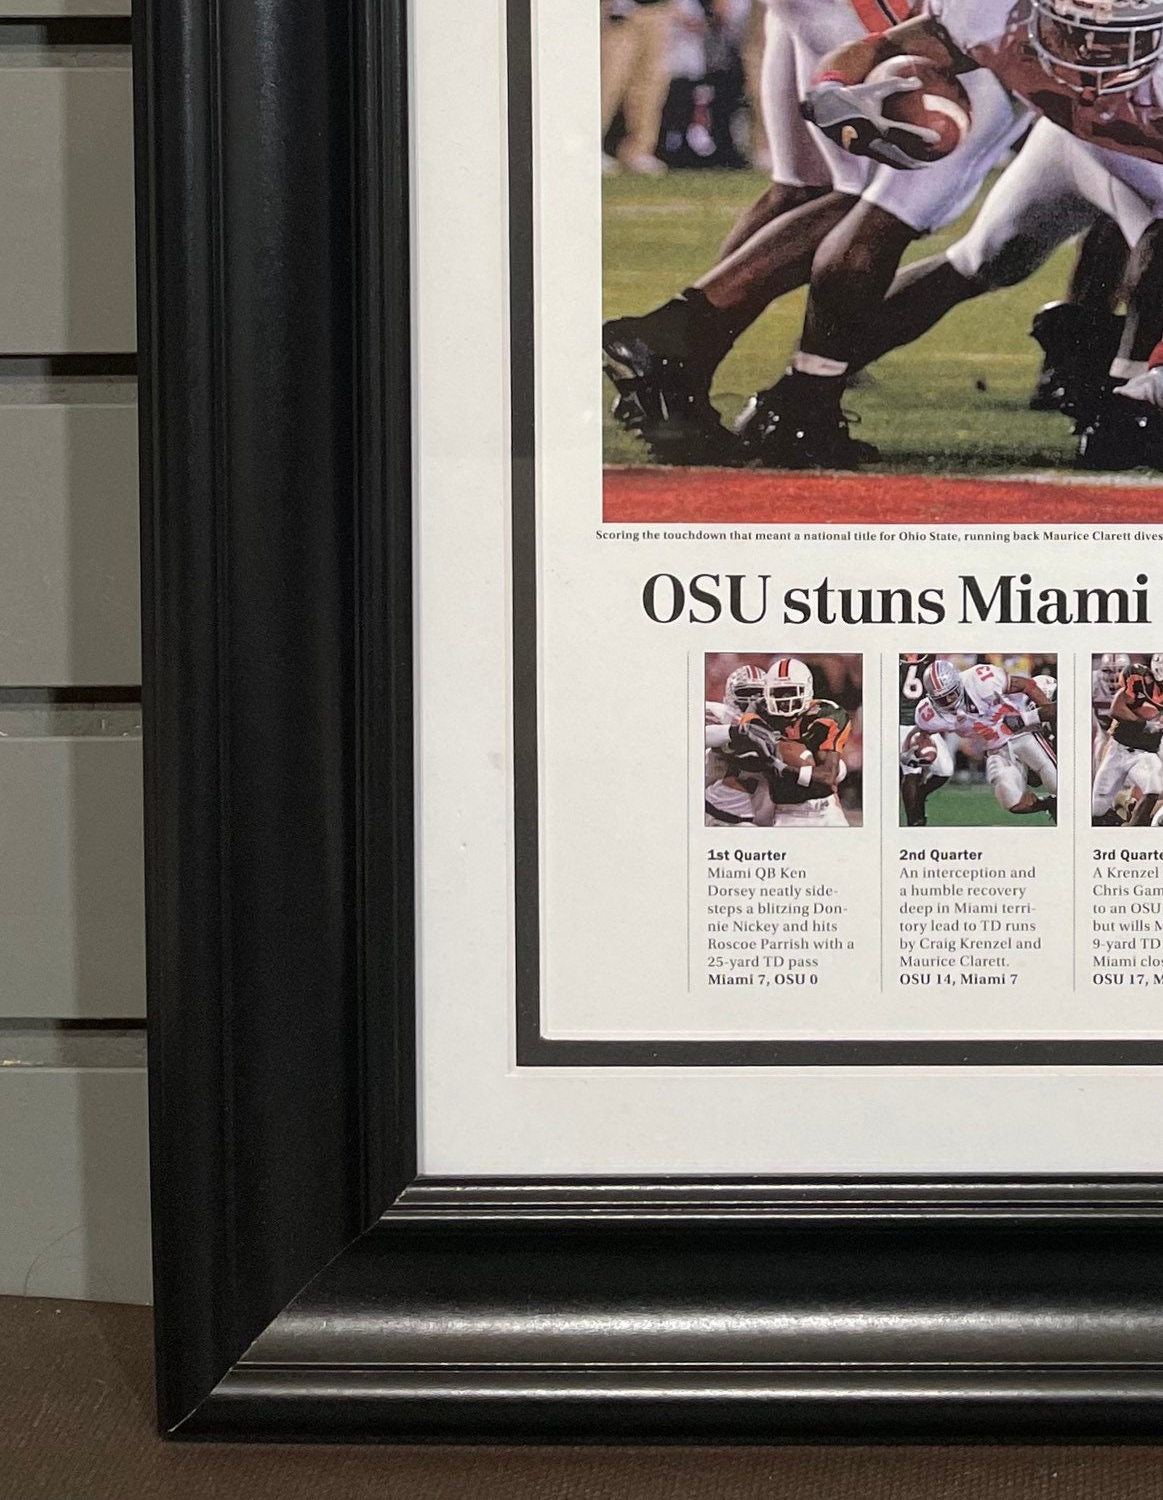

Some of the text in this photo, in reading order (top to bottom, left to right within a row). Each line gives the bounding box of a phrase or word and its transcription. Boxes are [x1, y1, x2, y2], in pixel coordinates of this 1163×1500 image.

[595, 529, 640, 543] Scoring
[641, 529, 661, 540] the
[662, 529, 728, 541] touchdown
[729, 530, 753, 541] that
[755, 531, 792, 541] meant
[793, 532, 801, 541] a
[803, 530, 851, 541] national
[853, 530, 878, 542] title
[879, 530, 897, 542] for
[898, 530, 927, 542] Ohio
[928, 530, 962, 543] State,
[963, 530, 1011, 544] running
[1012, 530, 1041, 542] back
[1042, 530, 1090, 541] Maurice
[1091, 530, 1132, 542] Clarett
[1133, 530, 1163, 541] dives
[643, 573, 771, 624] OSU
[784, 577, 945, 624] stuns
[958, 574, 1152, 624] Miami
[706, 848, 788, 864] 1st Quarter
[898, 848, 984, 863] 2nd Quarter
[1092, 848, 1117, 861] 3rd
[707, 866, 807, 882] Miami QB Ken
[898, 865, 1036, 882] An interception and
[1092, 866, 1103, 879] A
[1106, 865, 1159, 879] Krenzel
[1092, 919, 1116, 933] but
[1118, 919, 1151, 932] wills
[707, 936, 855, 951] Roscoe Parrish with a
[899, 936, 1042, 954] by Craig Krenzel and
[707, 954, 819, 971] 25-yard TD pass
[899, 955, 956, 968] Maurice
[1092, 955, 1137, 968] Miami
[707, 973, 819, 988] Miami 7, OSU 0
[899, 972, 1019, 987] OSU 14, Miami 7
[1092, 972, 1125, 986] OSU
[1129, 973, 1149, 987] 17,
